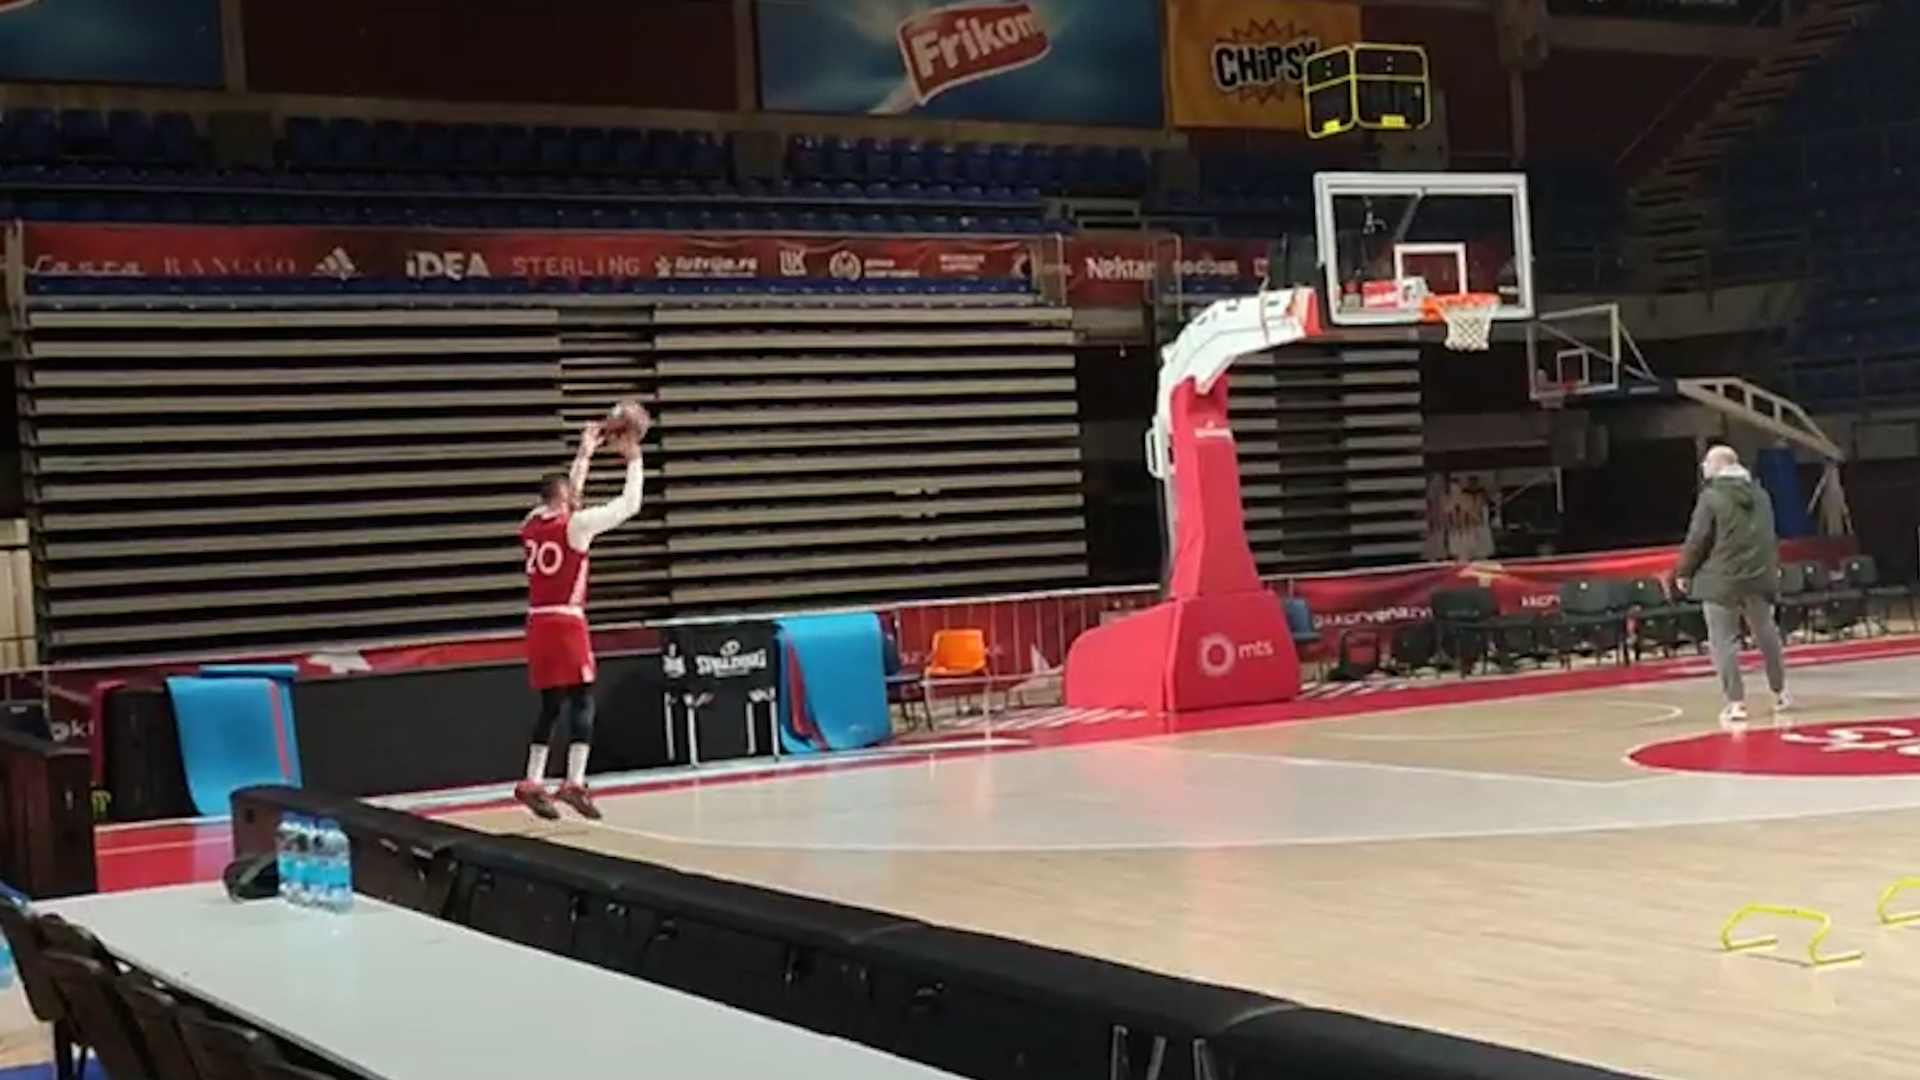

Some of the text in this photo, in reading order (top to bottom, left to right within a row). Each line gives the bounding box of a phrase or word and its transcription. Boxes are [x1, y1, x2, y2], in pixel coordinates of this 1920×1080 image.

[511, 255, 641, 277] STERLING
[526, 538, 563, 575] 20
[1238, 641, 1274, 659] mts
